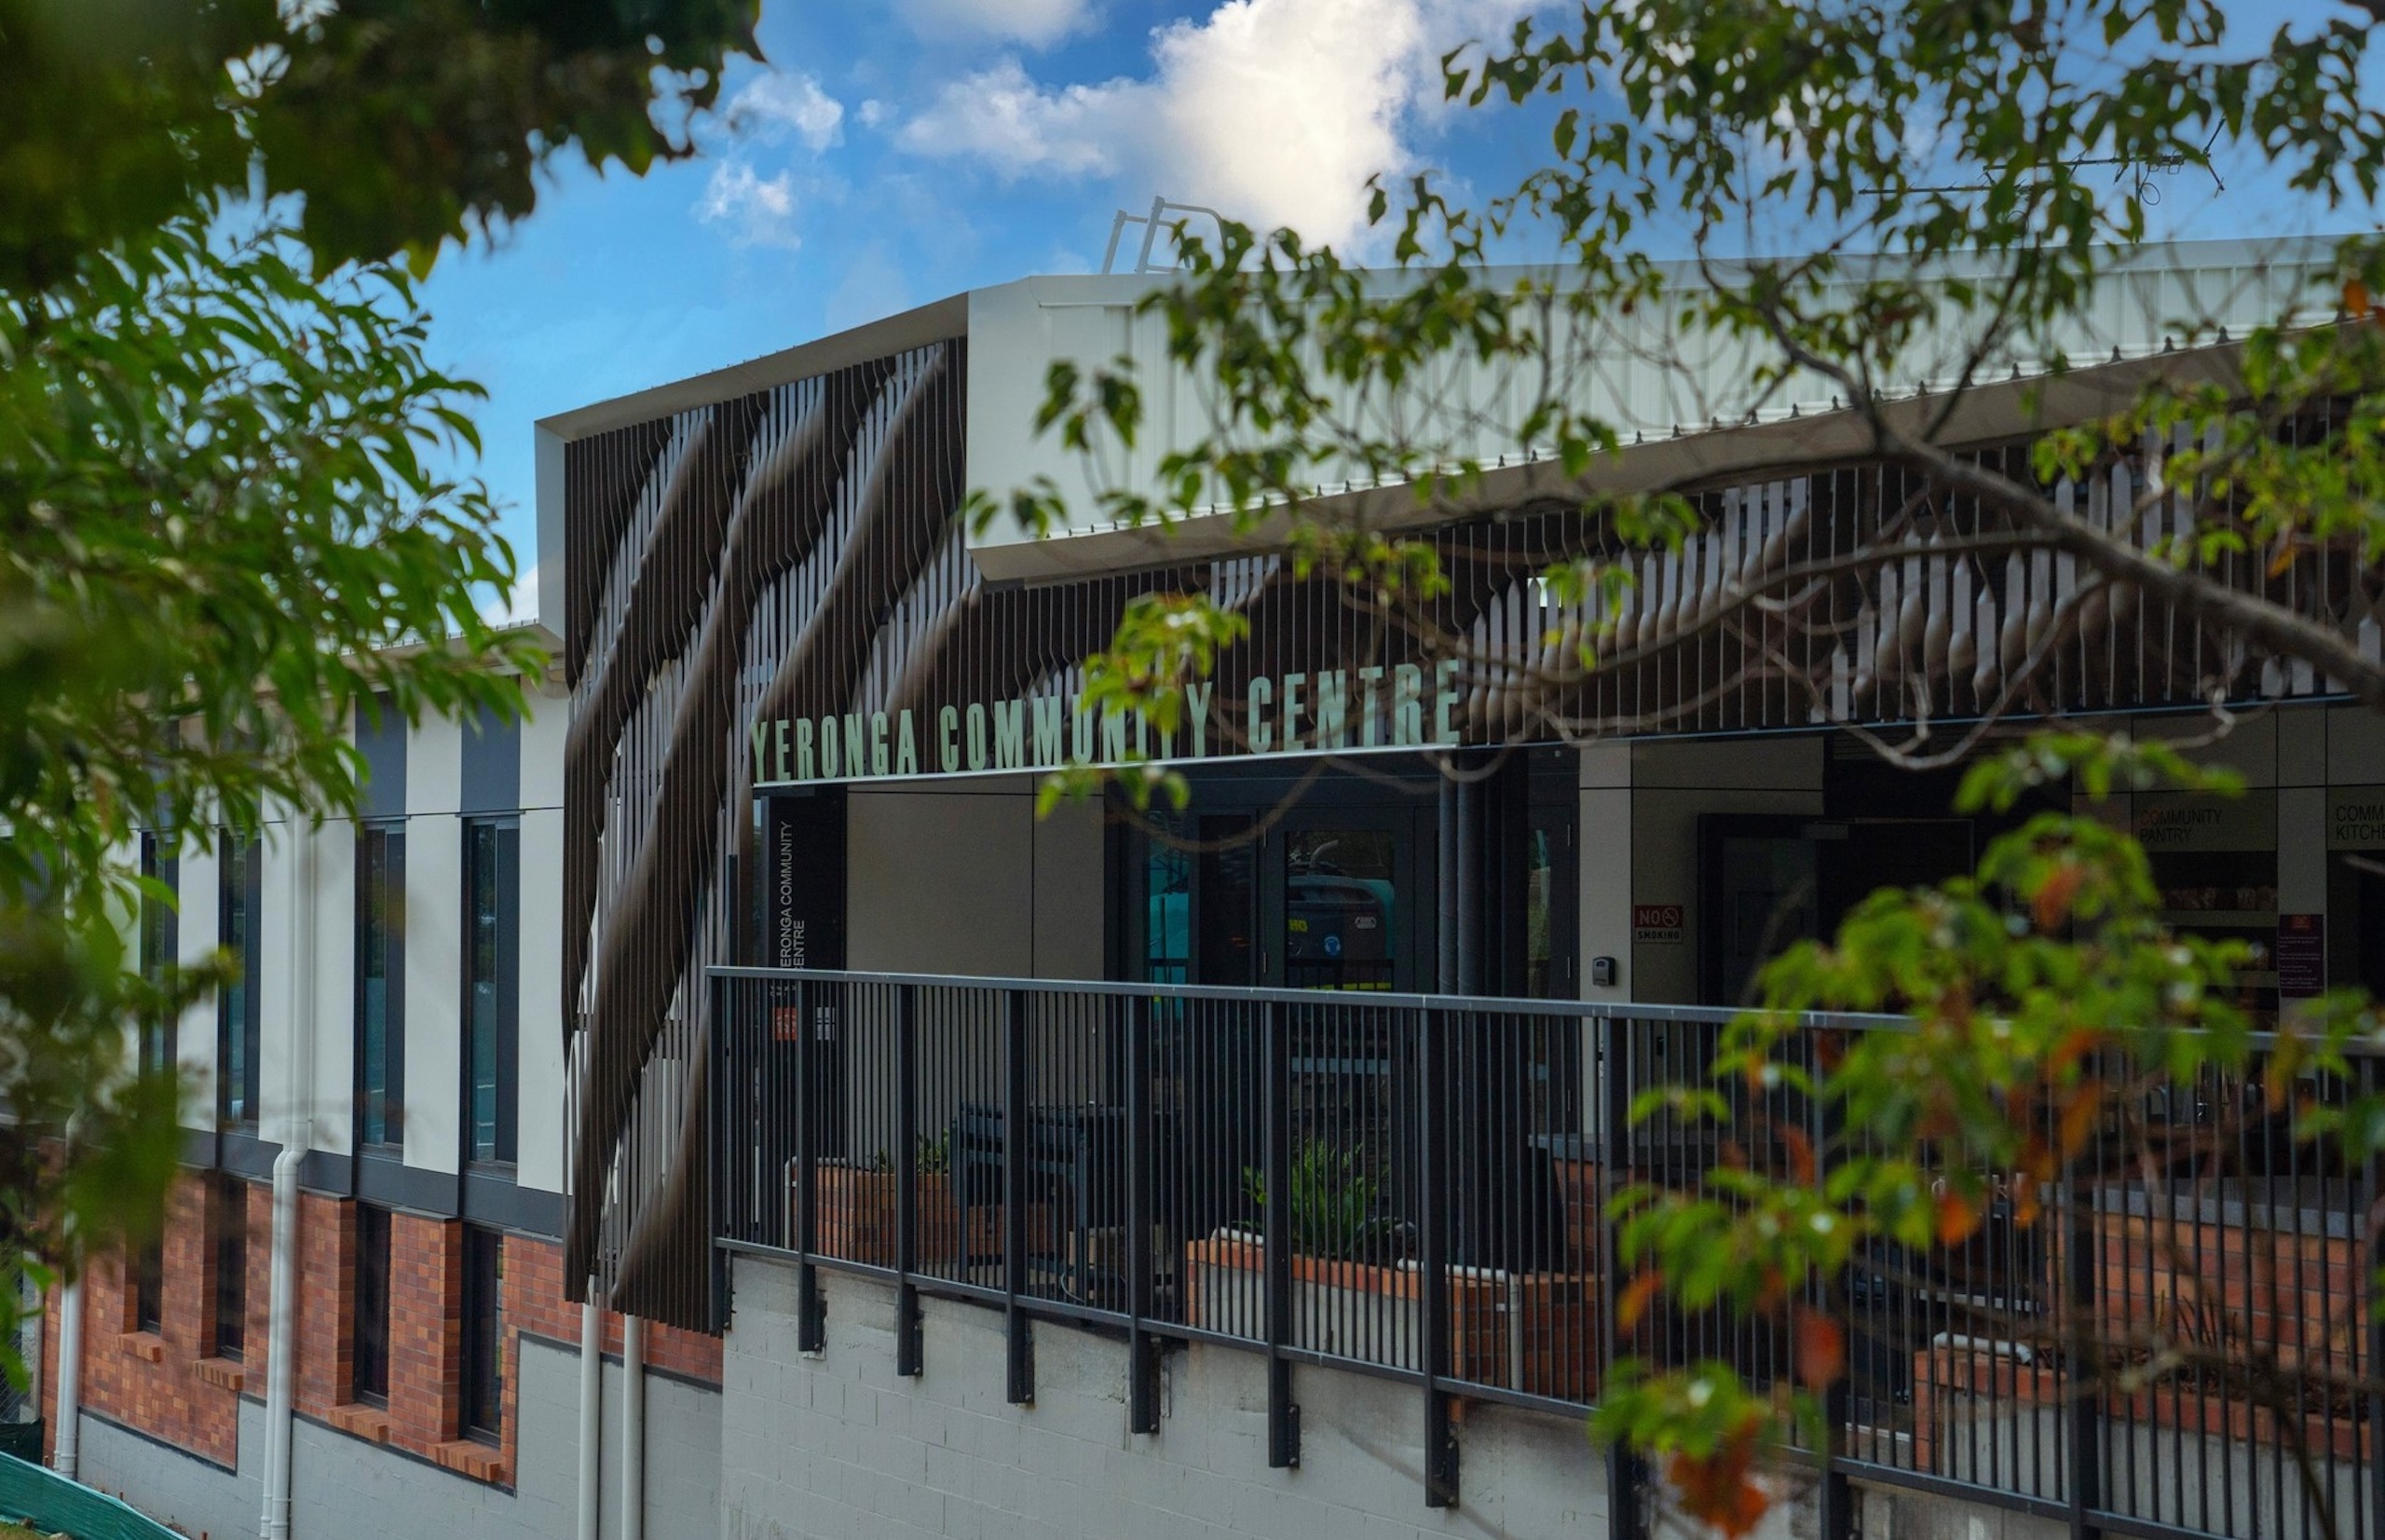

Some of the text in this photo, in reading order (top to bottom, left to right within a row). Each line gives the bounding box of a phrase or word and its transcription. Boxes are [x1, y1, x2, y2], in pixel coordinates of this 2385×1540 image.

[750, 709, 918, 784] YERONGA
[1247, 659, 1461, 754] CENTRE
[2139, 809, 2224, 825] COMMUNITY
[2139, 827, 2193, 843] PANTRY
[780, 821, 793, 906] COMMUNITY
[1639, 909, 1660, 925] NO
[780, 907, 793, 970] ERONGA
[793, 920, 805, 971] ENTRE
[1637, 931, 1680, 940] SMOKING
